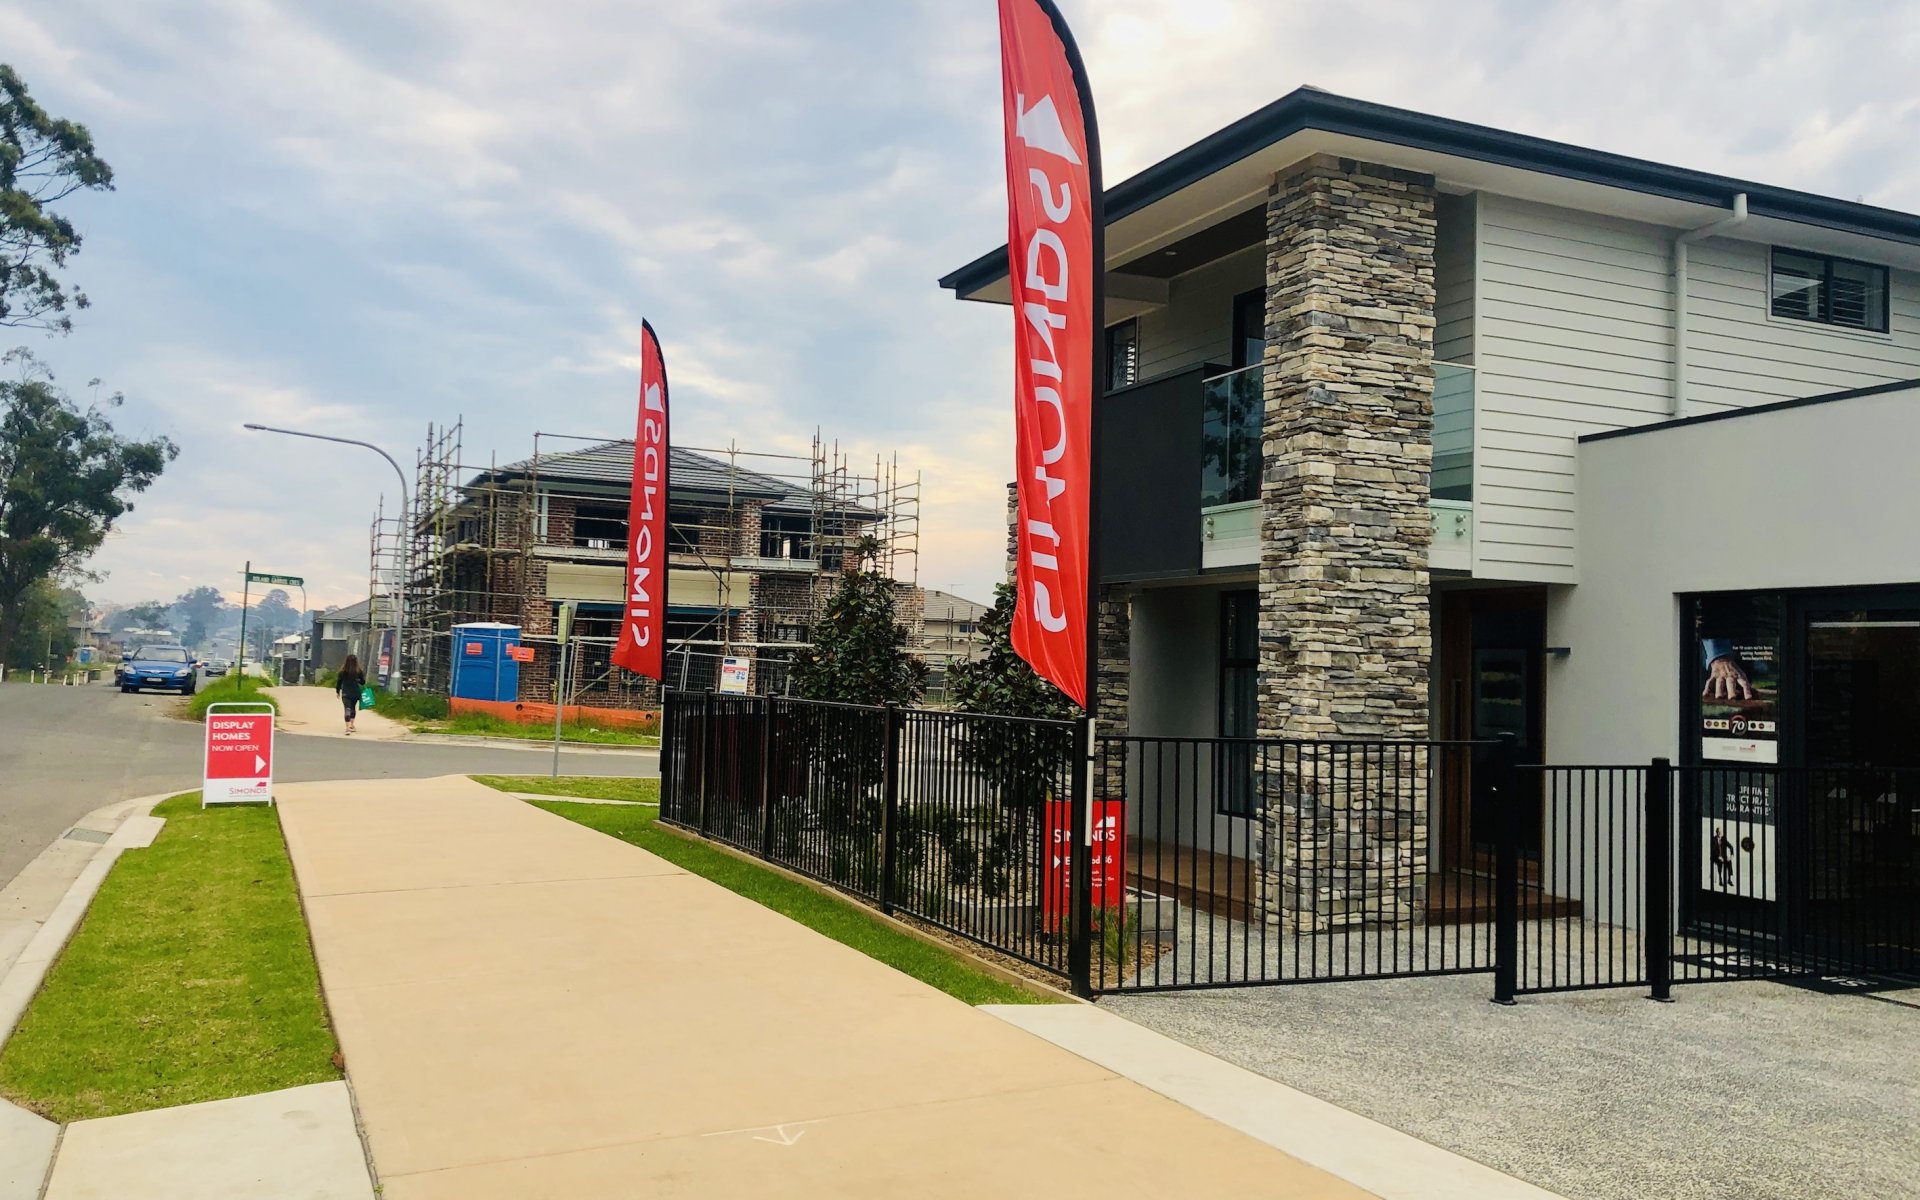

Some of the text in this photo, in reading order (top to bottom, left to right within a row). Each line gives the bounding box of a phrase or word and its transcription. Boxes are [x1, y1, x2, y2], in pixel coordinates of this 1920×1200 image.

[213, 721, 255, 729] DISPLAY
[1732, 720, 1745, 734] 70
[212, 732, 251, 740] HOMES
[229, 787, 267, 795] SIMONDS
[1054, 829, 1116, 843] SINDS
